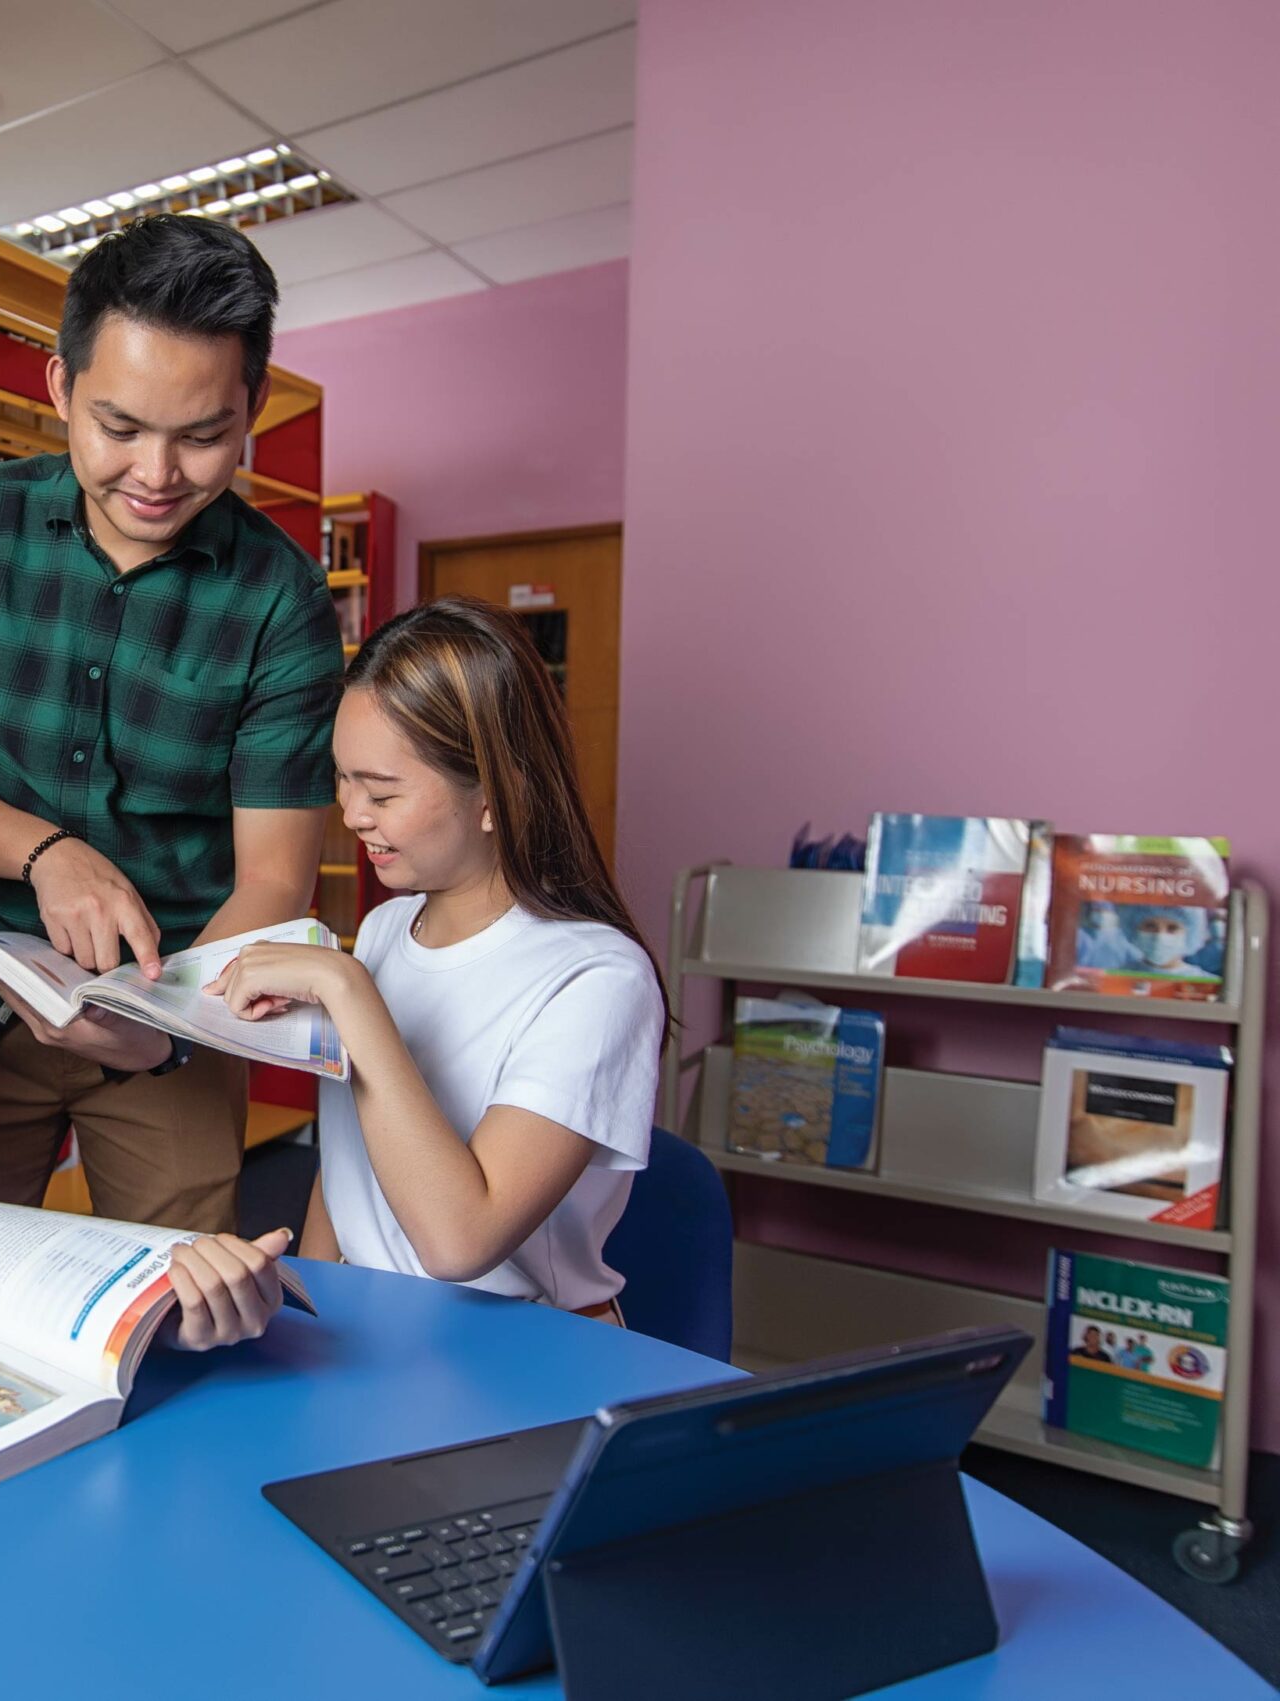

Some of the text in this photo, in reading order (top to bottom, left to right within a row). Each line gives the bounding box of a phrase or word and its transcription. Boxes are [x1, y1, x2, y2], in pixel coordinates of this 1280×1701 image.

[1079, 874, 1195, 898] NURSING
[784, 1035, 873, 1064] Psychology
[126, 1261, 164, 1289] Dreams
[1077, 1286, 1194, 1328] NCLEX-RN
